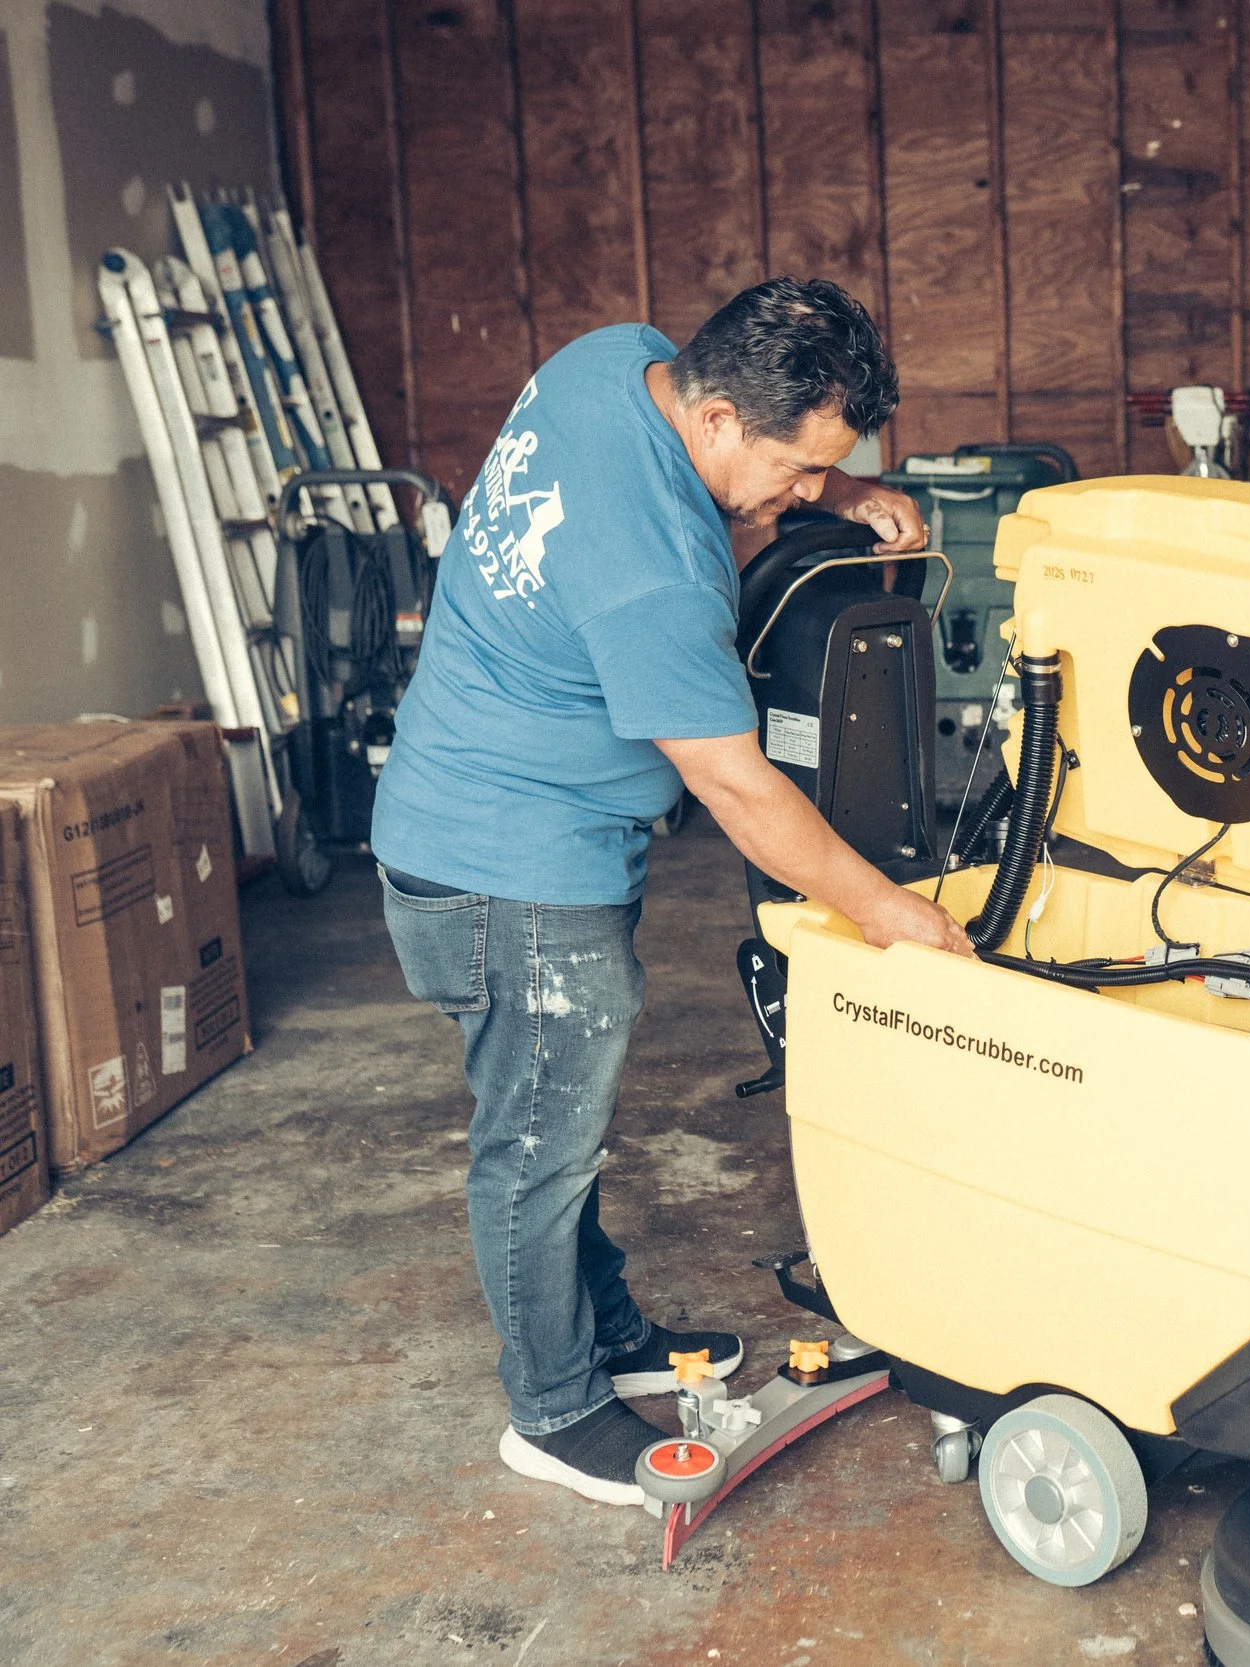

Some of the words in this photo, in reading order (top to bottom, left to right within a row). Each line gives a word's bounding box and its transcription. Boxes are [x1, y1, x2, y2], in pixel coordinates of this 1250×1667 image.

[484, 450, 507, 532] NING,
[498, 530, 539, 610] INC.
[505, 480, 565, 587] A
[833, 992, 1084, 1084] CrystalFloorScrubber.com
